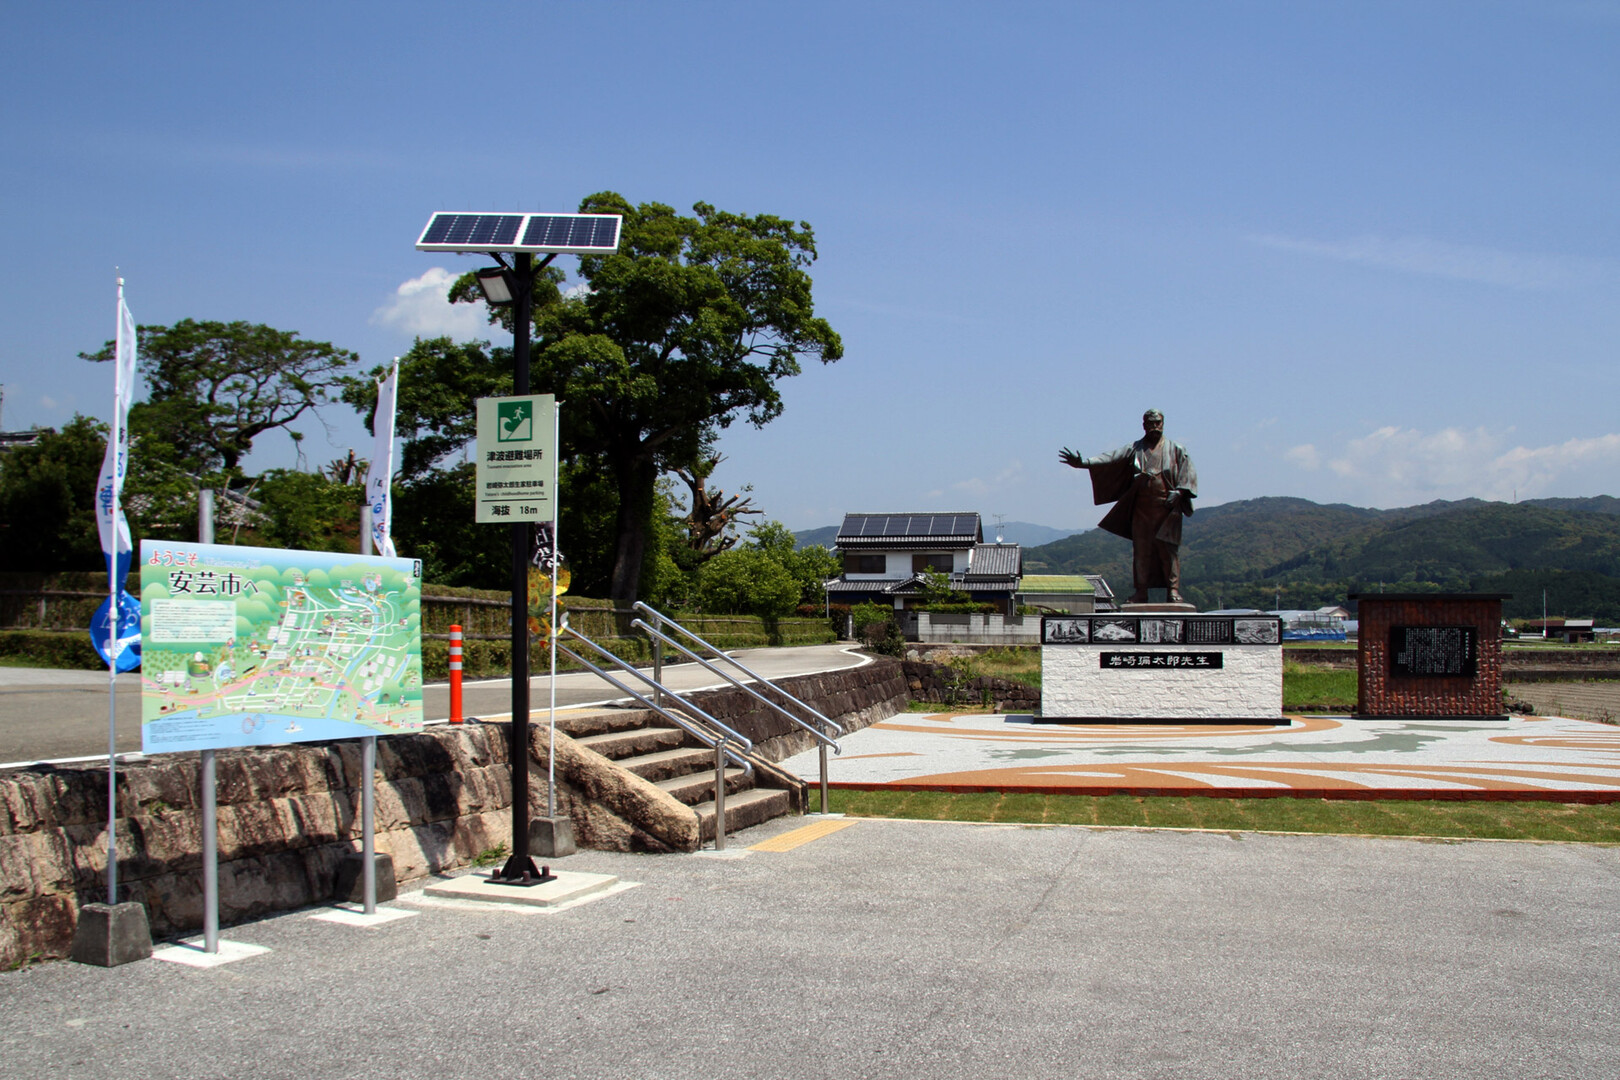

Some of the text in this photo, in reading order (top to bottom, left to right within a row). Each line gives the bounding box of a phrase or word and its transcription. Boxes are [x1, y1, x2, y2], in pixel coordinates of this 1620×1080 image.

[486, 449, 543, 461] 津波避難場所
[491, 505, 538, 516] 海抜 18m
[149, 549, 199, 567] ようこそ
[169, 570, 259, 595] 安芸市へ
